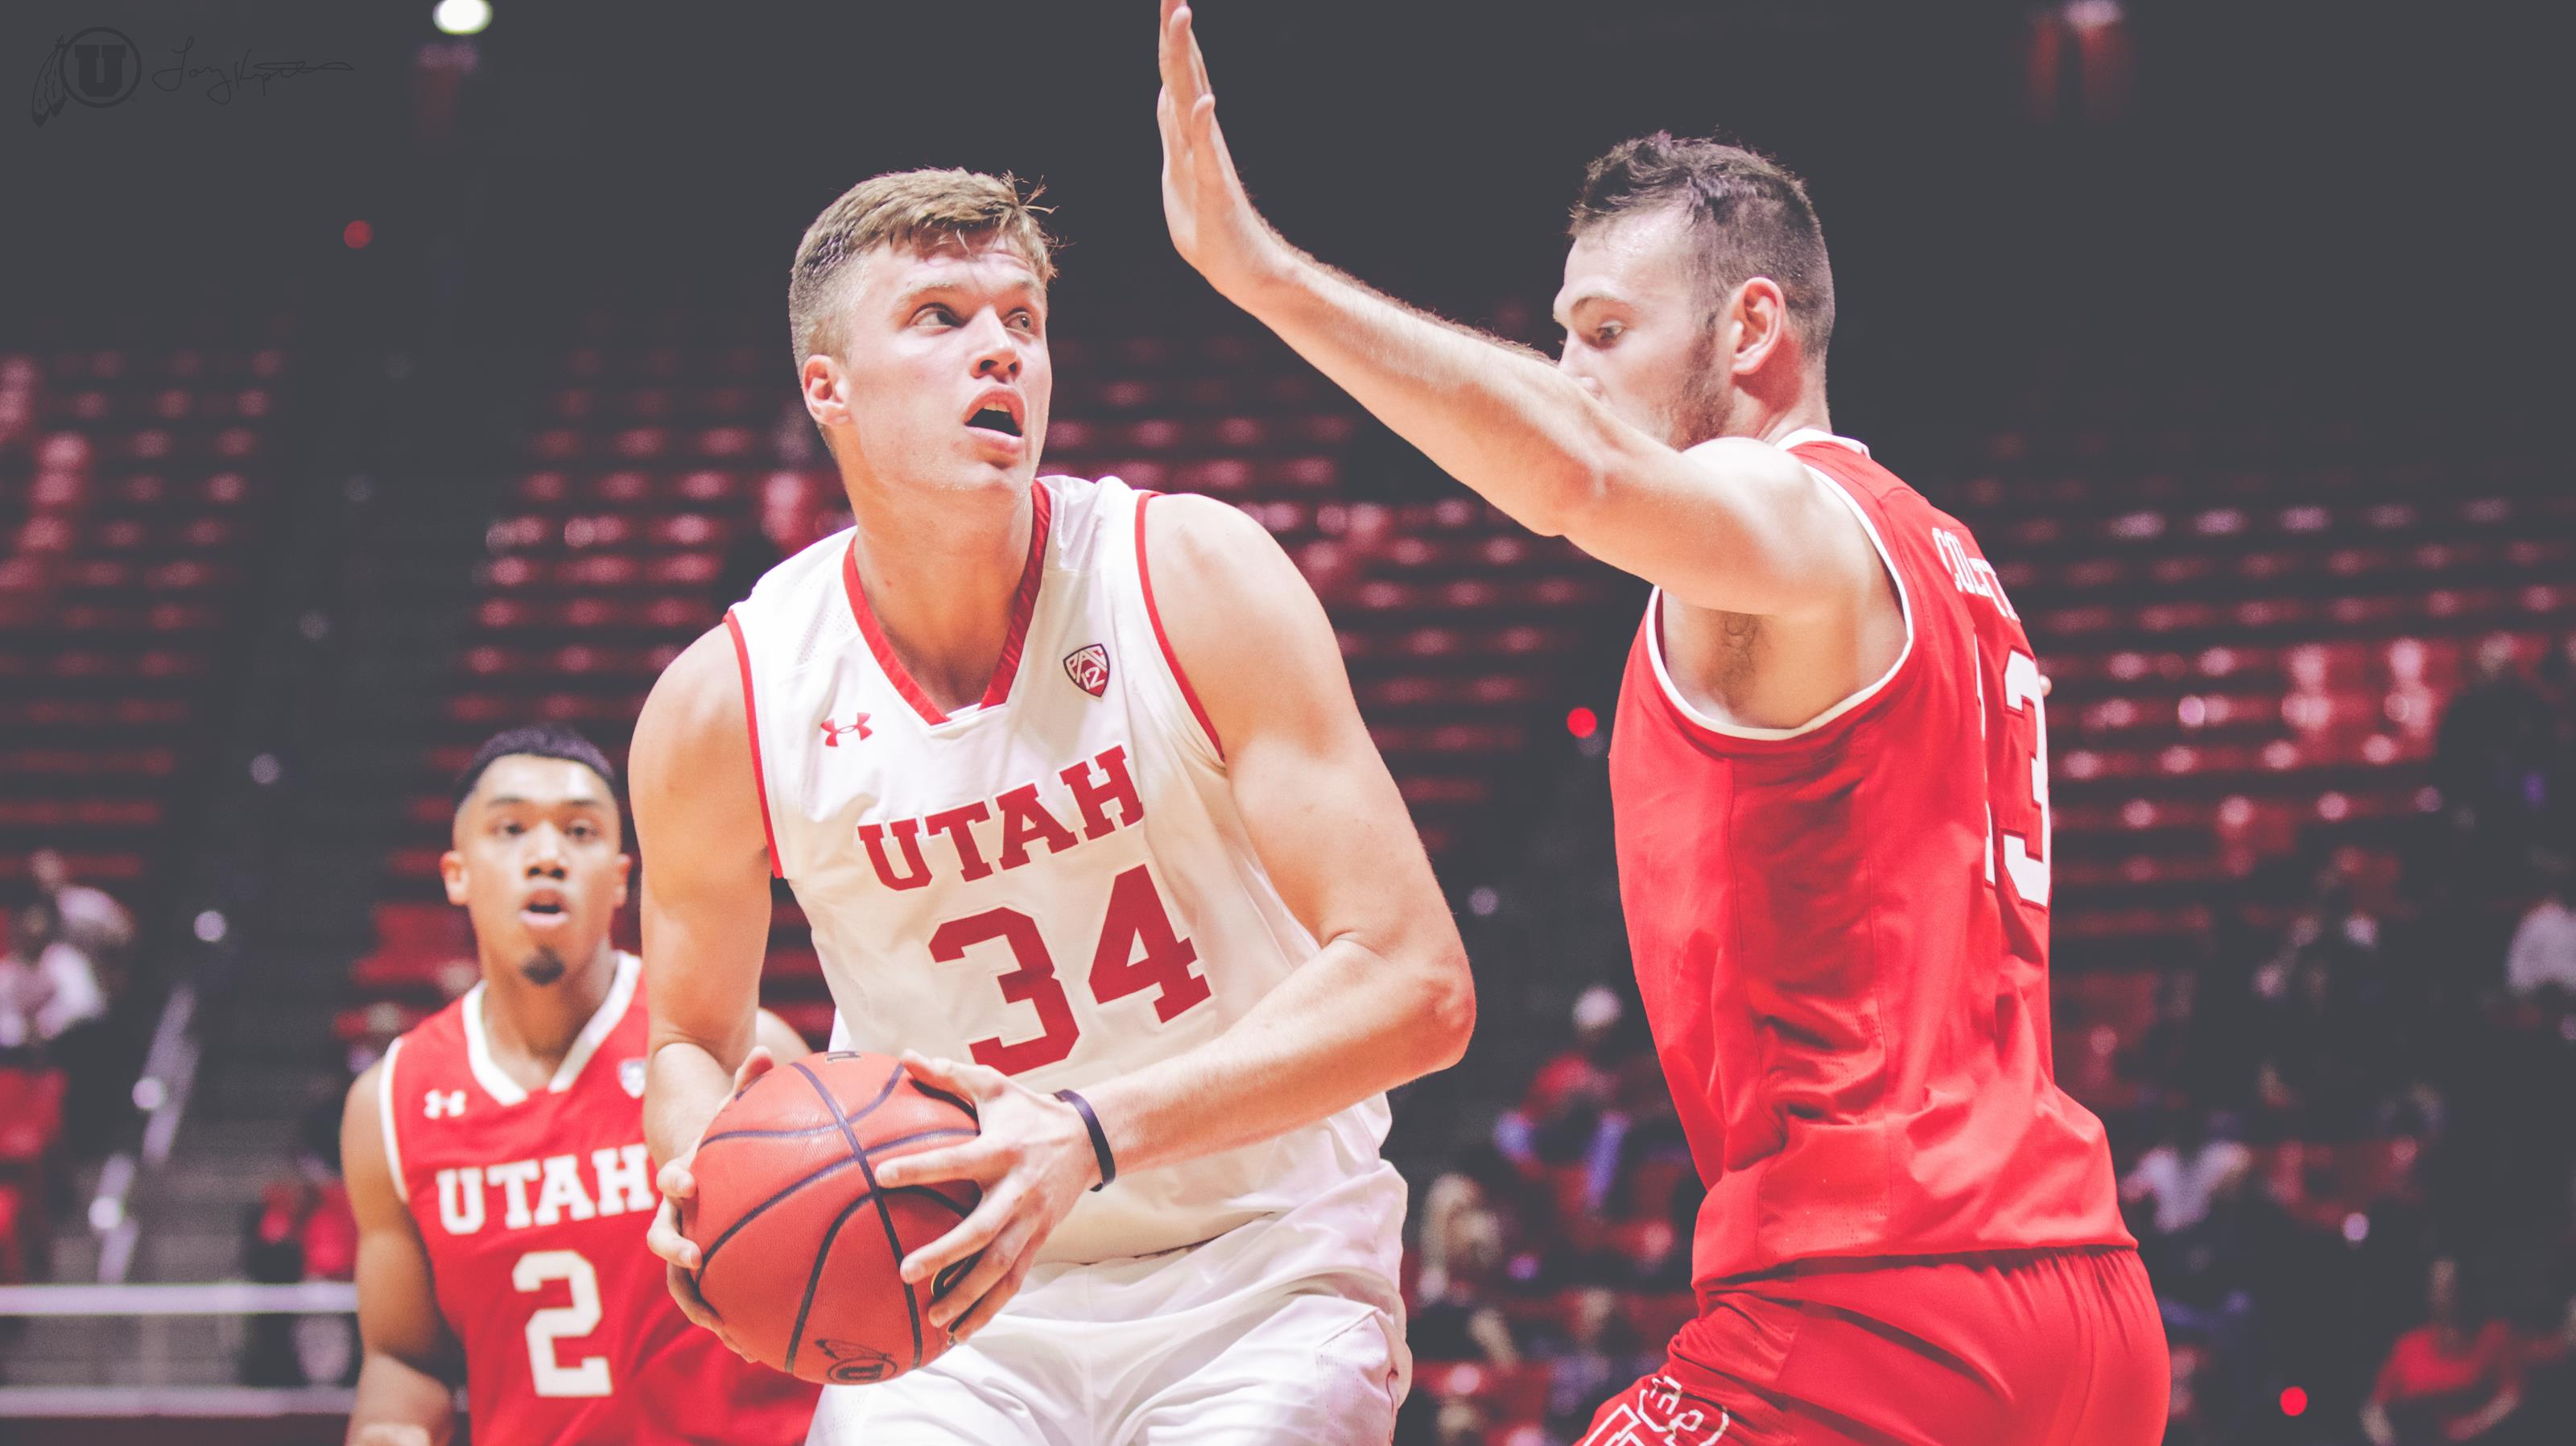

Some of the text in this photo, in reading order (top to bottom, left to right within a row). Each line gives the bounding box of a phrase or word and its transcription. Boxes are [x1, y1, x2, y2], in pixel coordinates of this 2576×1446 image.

[1080, 666, 1105, 690] 12
[857, 744, 1144, 891] UTAH
[928, 864, 1212, 1077] 34
[436, 1142, 655, 1235] UTAH
[512, 1249, 613, 1398] 2
